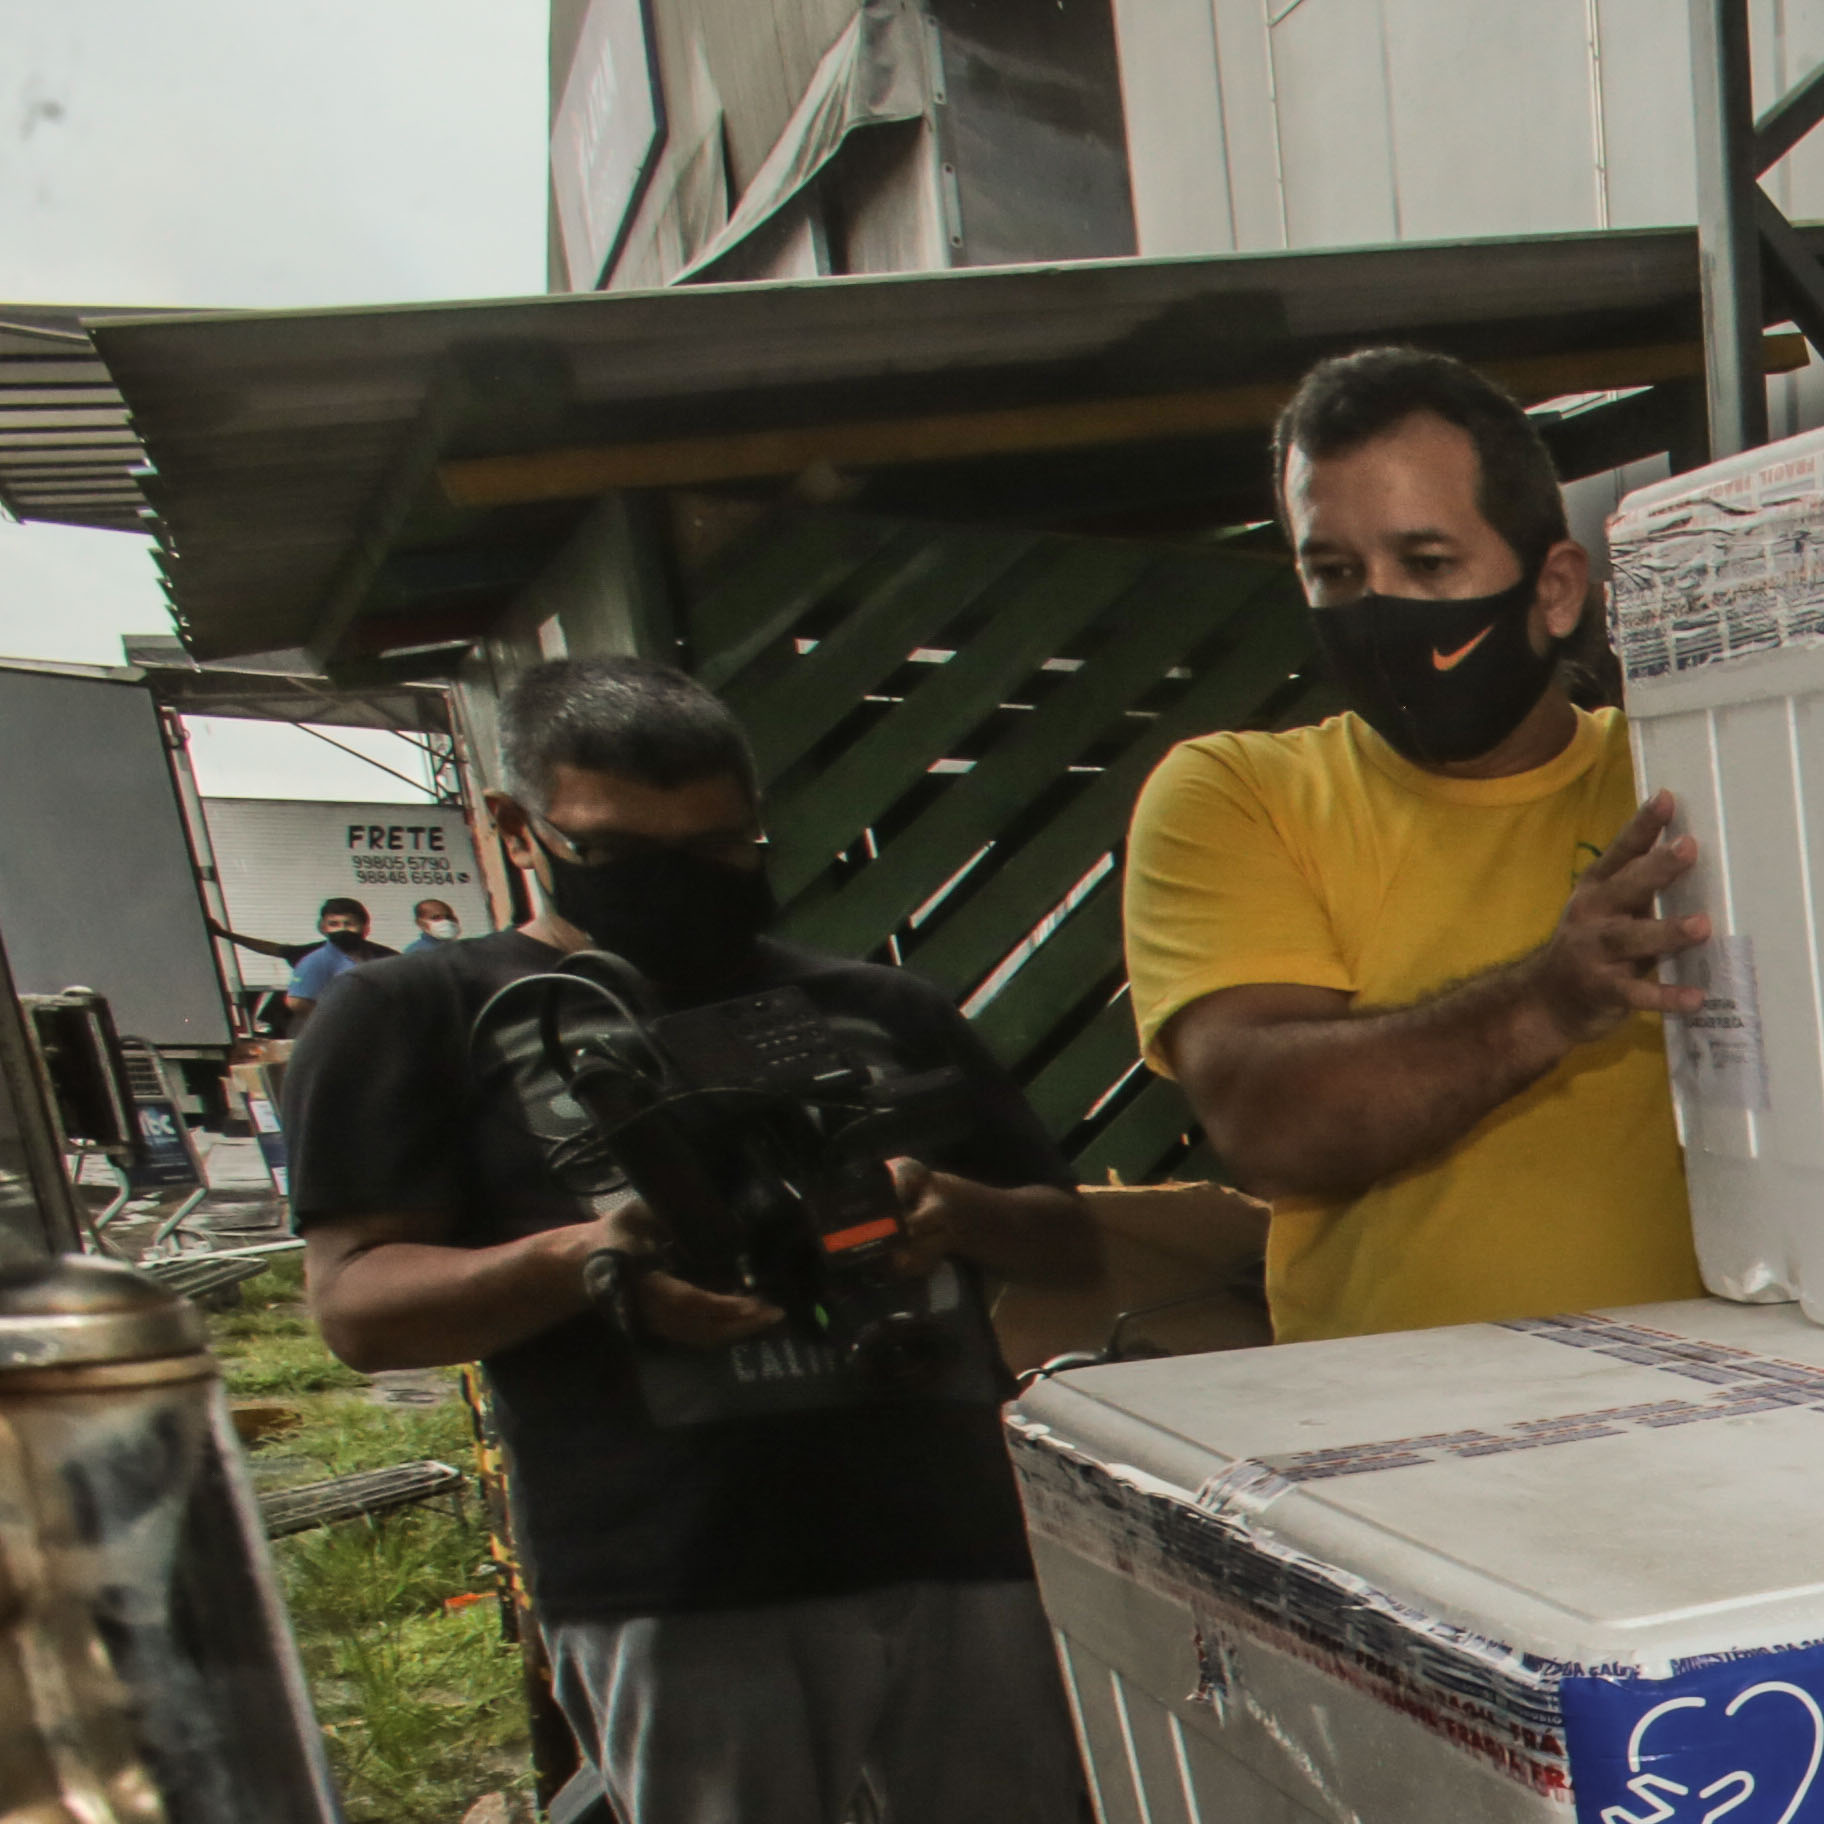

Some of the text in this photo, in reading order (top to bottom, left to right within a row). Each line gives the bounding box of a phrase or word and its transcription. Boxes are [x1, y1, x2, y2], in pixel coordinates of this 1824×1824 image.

[348, 825, 445, 850] FRETE
[408, 857, 449, 870] 5790
[412, 871, 454, 885] 6584
